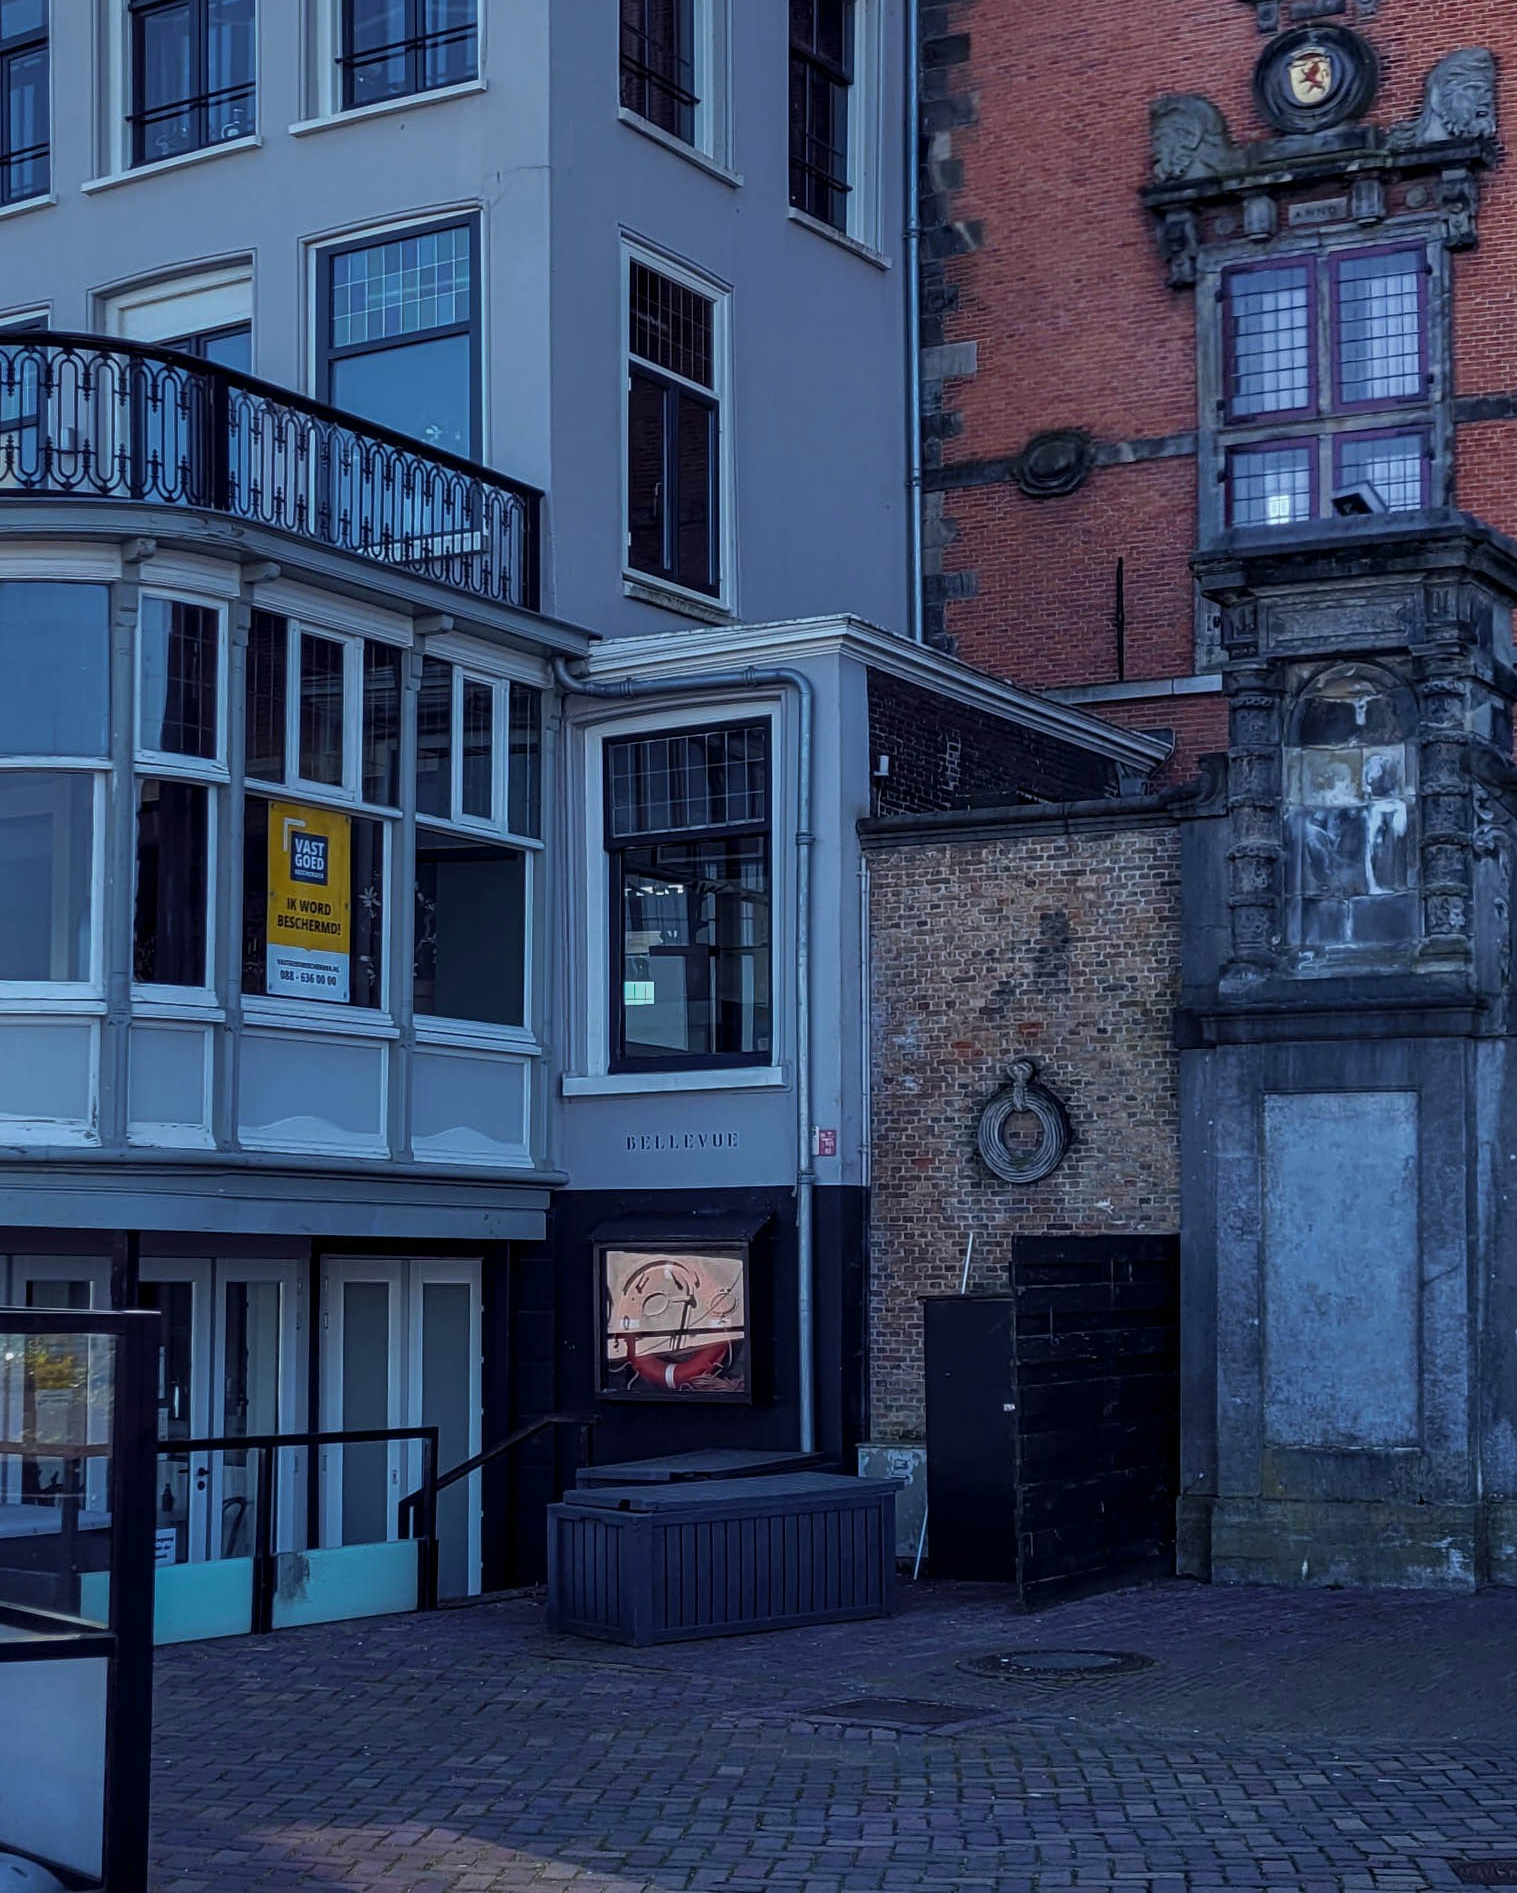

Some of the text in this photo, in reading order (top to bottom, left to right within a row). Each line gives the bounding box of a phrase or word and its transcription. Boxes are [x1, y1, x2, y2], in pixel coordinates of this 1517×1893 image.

[294, 838, 325, 856] VAST
[294, 854, 325, 871] GOED
[286, 897, 331, 916] IK WORD
[277, 914, 342, 936] BESCHERMD!
[626, 1132, 739, 1151] BELLEVUE
